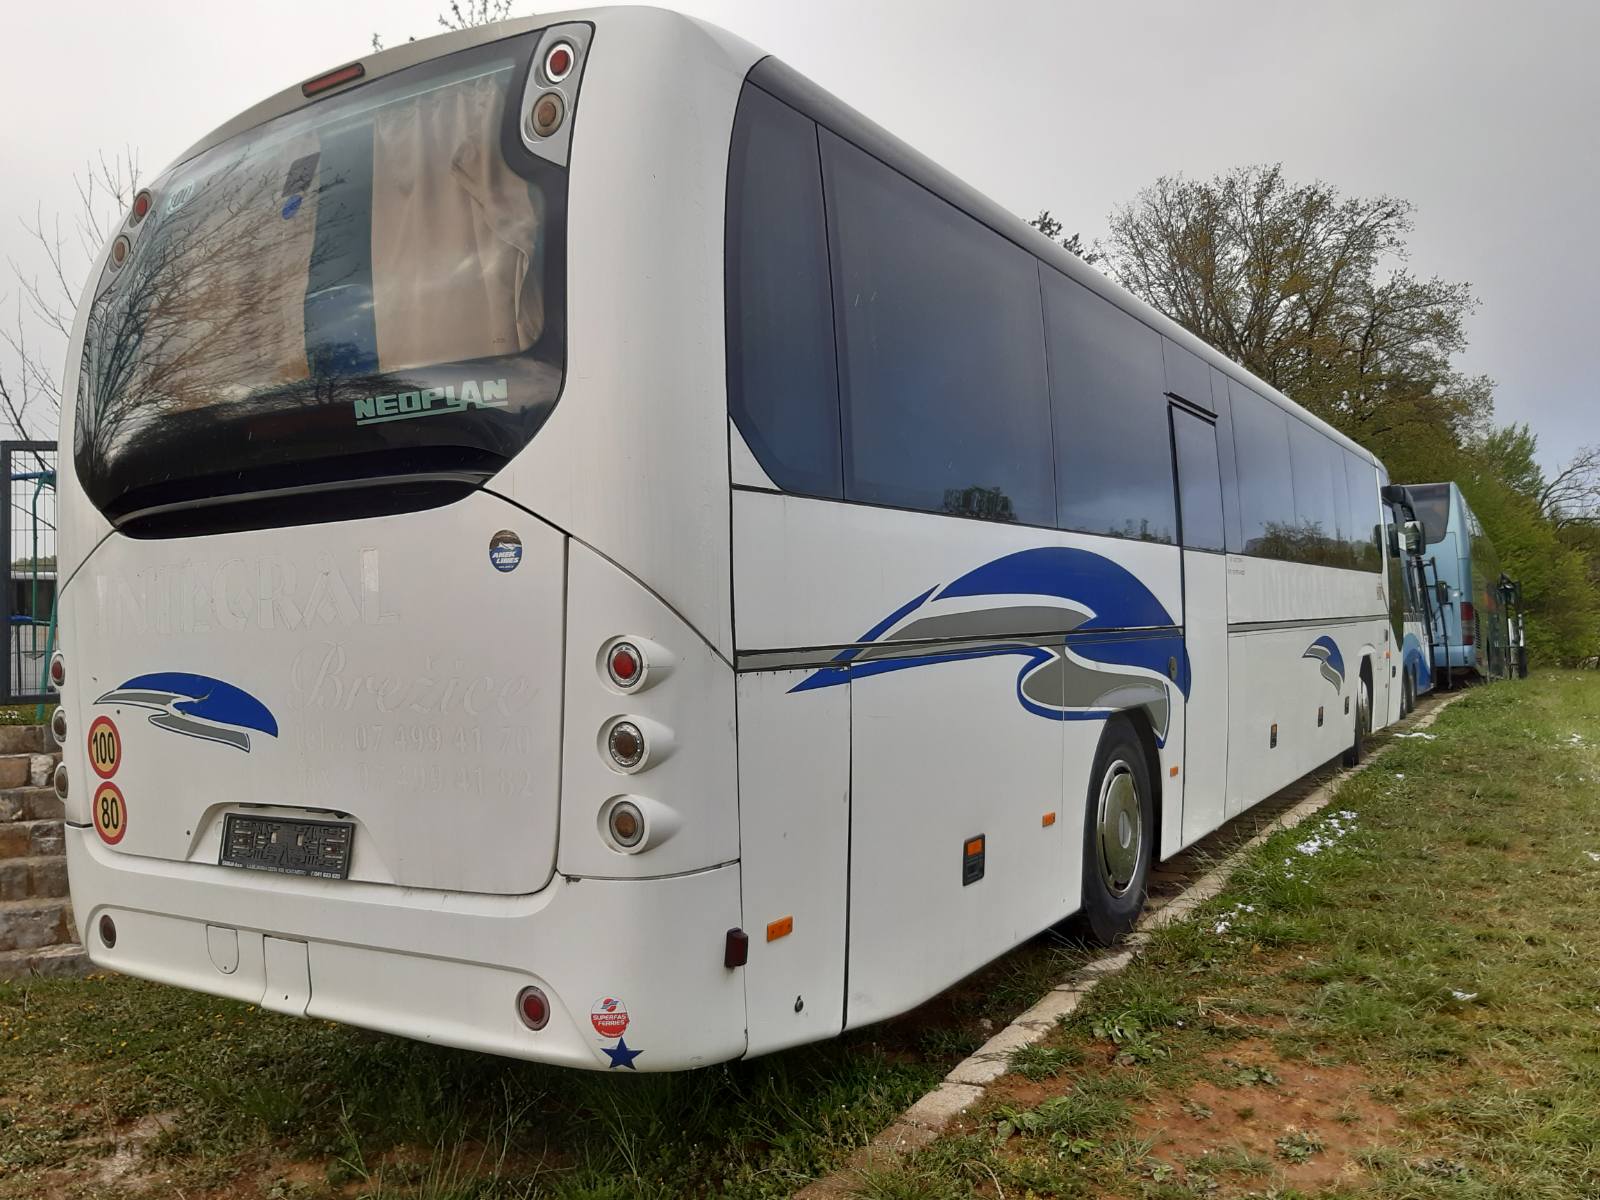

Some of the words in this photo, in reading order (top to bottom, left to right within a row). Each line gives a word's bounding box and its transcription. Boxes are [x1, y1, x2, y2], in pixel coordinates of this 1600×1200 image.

[354, 379, 508, 425] NEOPLAN
[92, 731, 115, 764] 100
[101, 797, 119, 829] 80
